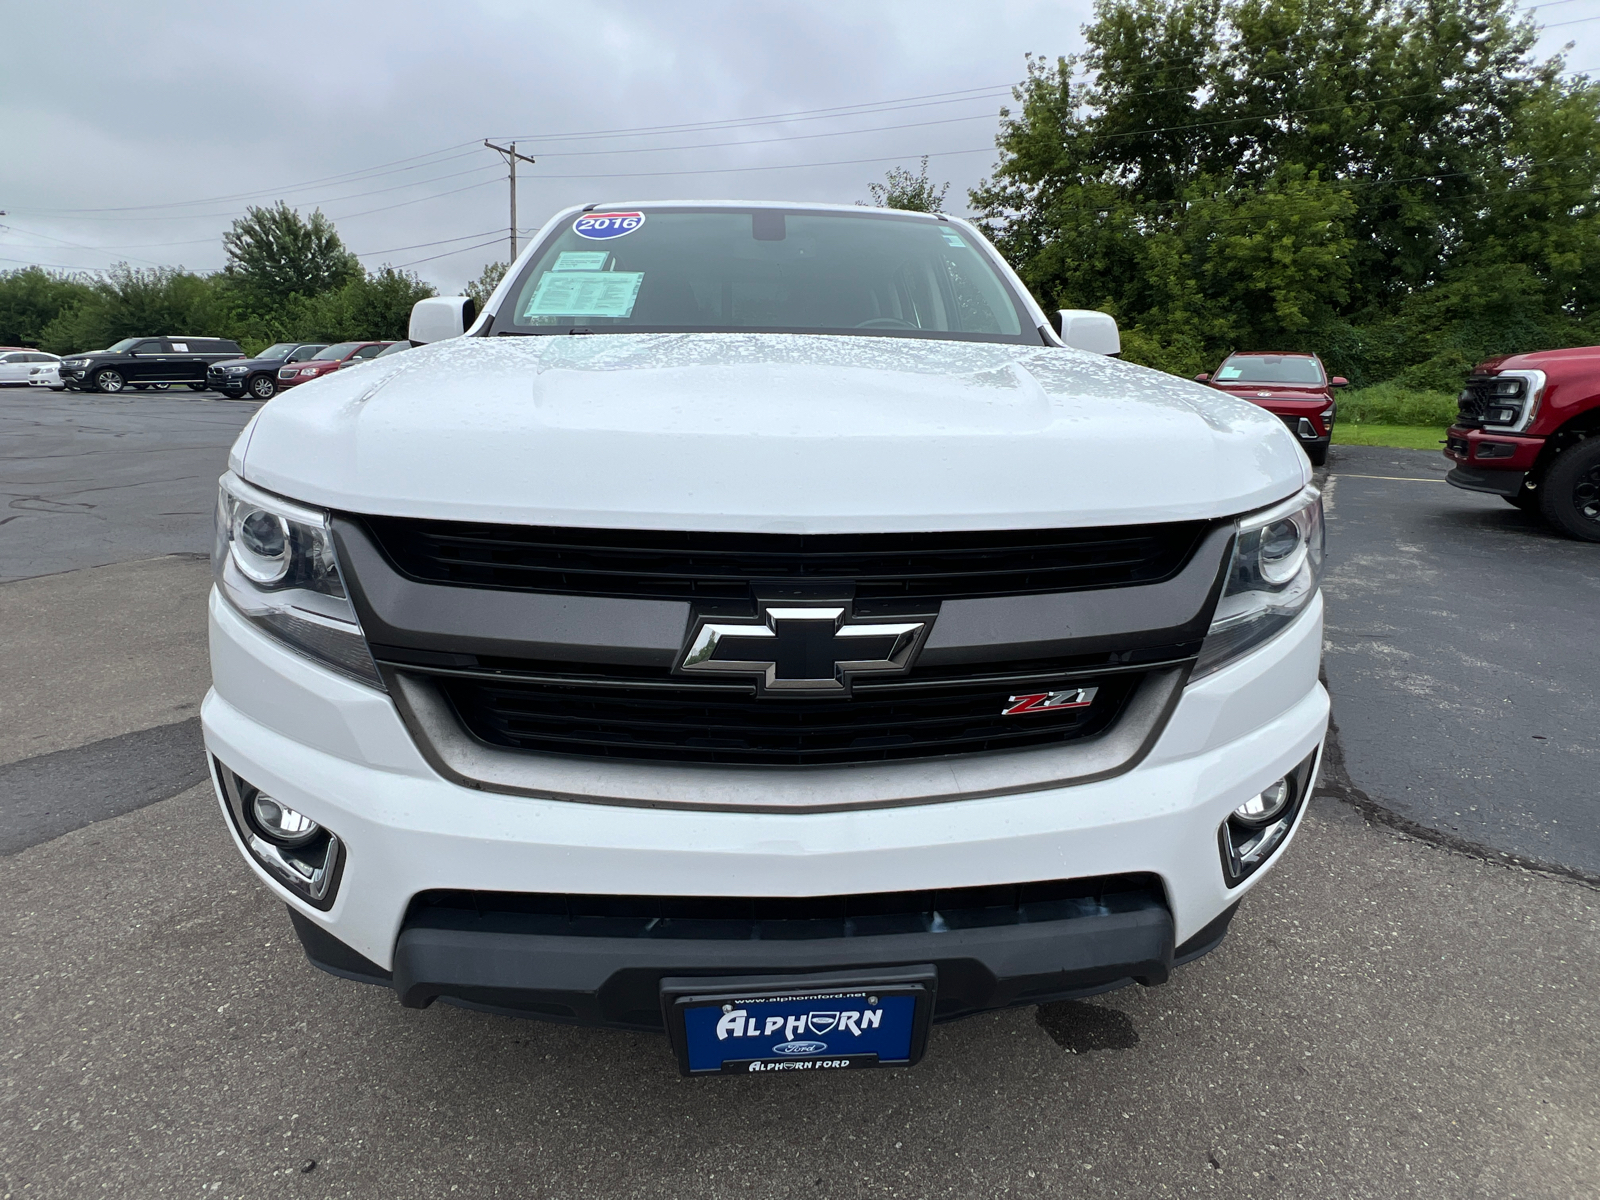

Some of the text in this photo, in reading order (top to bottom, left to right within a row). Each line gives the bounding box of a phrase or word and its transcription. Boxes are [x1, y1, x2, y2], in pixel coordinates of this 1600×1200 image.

[577, 218, 639, 230] 2016
[1001, 687, 1099, 715] Z71
[734, 992, 867, 1004] www.alphornford.net
[815, 1060, 850, 1069] FORD
